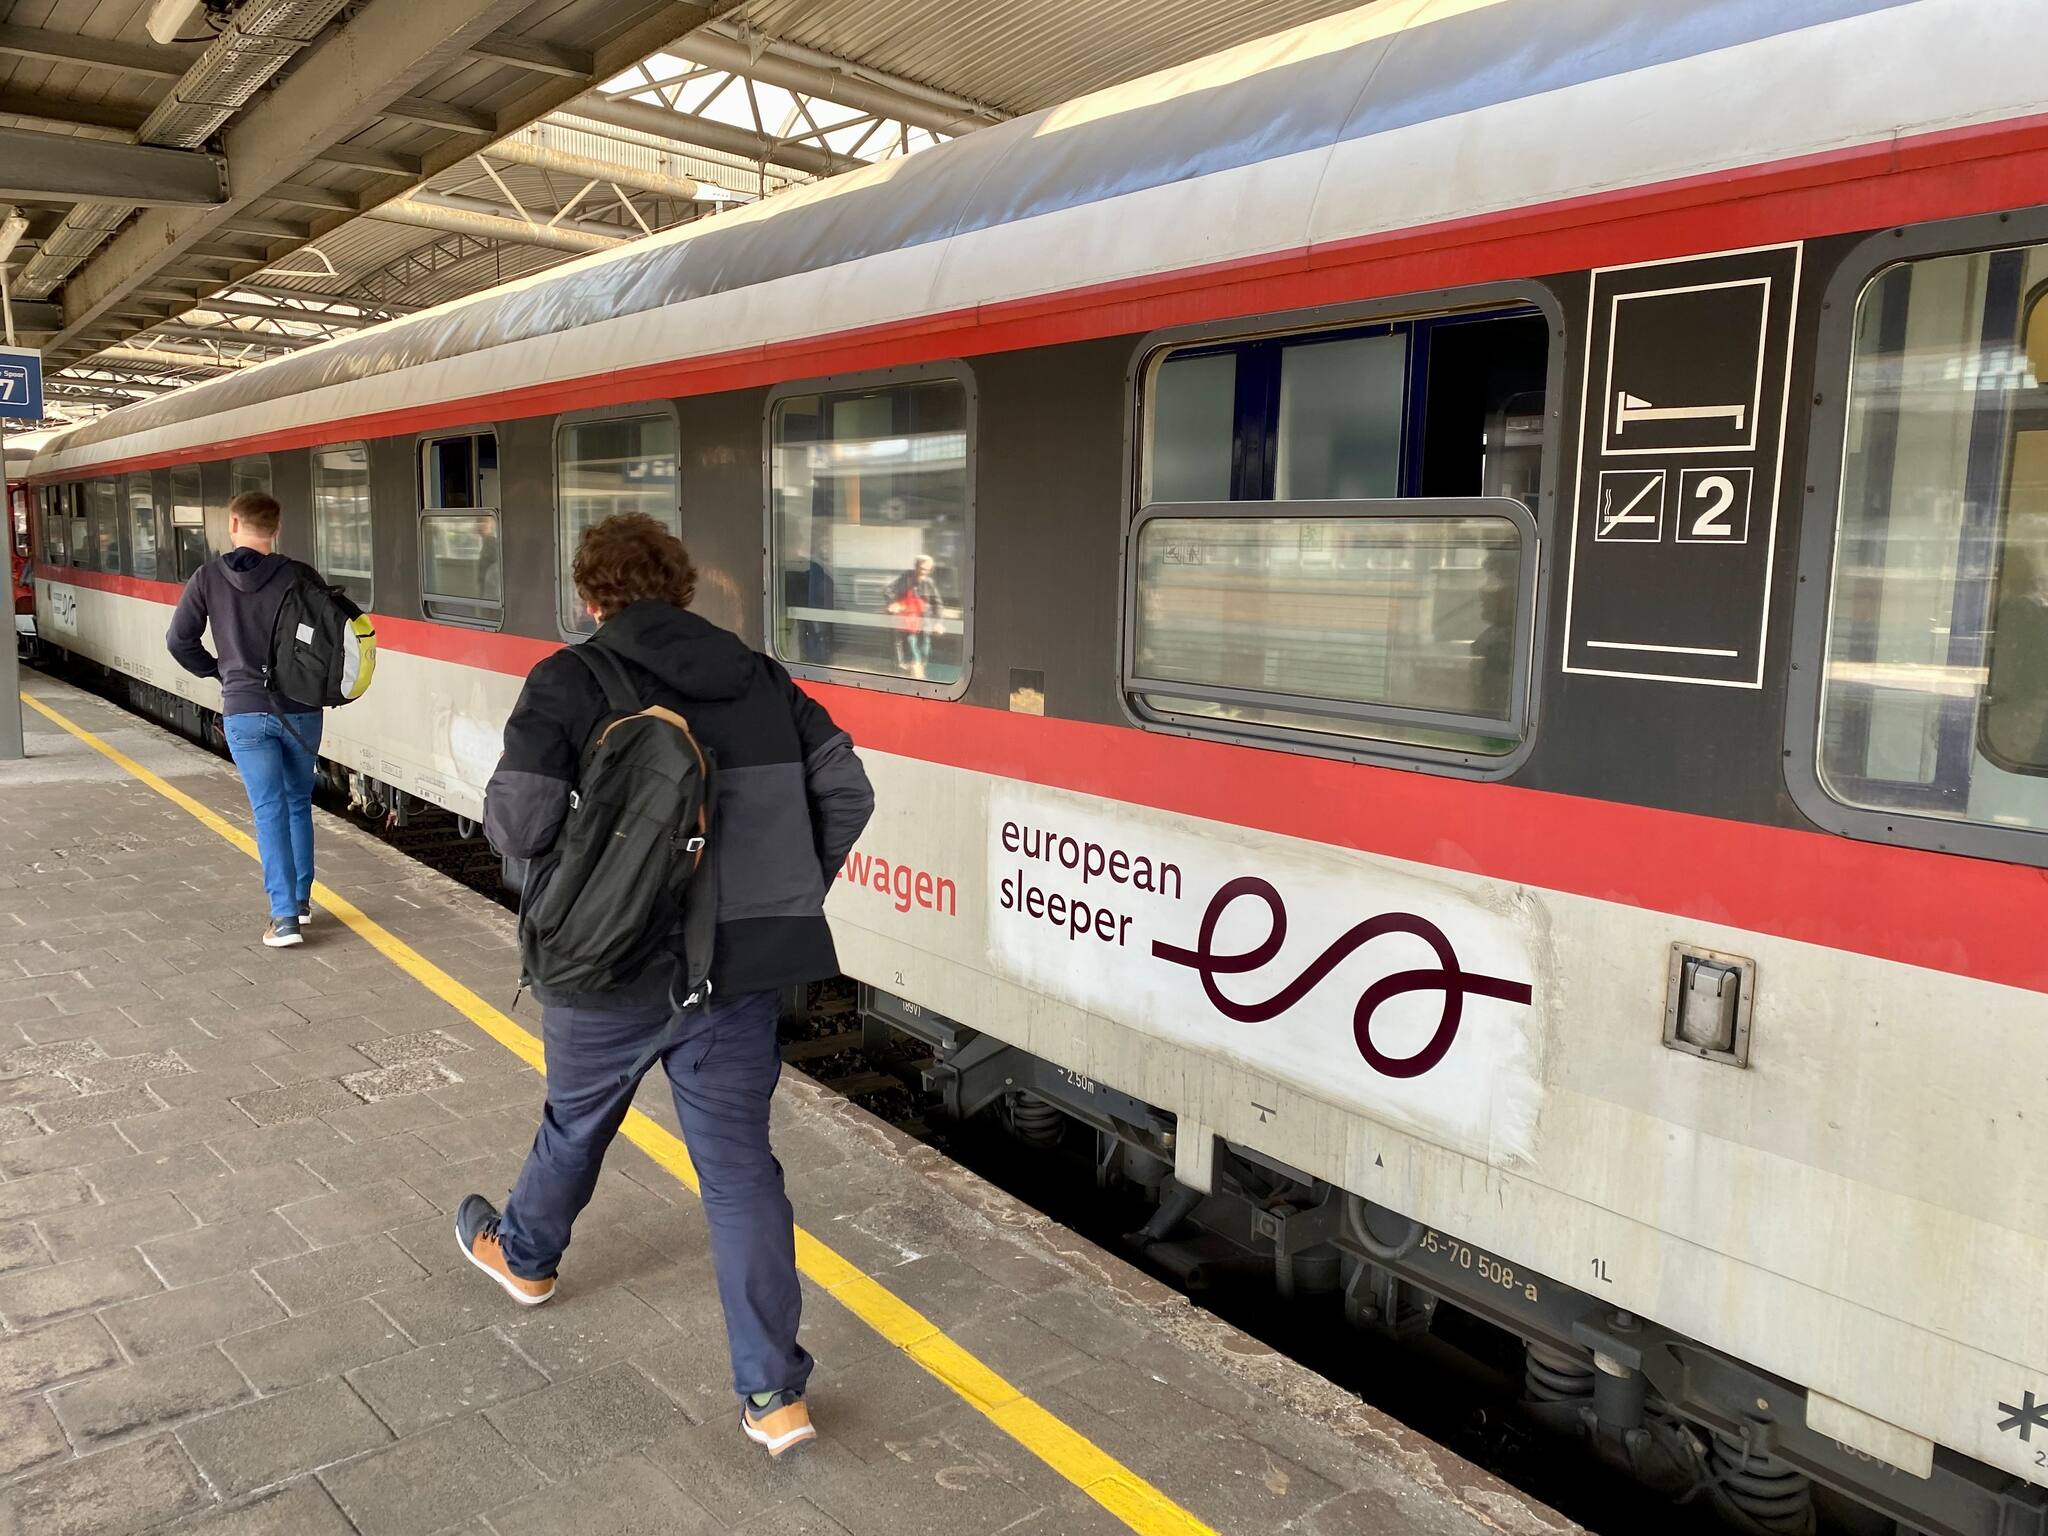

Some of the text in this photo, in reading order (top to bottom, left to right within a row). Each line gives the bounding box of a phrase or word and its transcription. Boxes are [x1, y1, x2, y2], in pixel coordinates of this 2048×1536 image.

[1692, 476, 1734, 535] 2
[838, 851, 956, 916] wagen
[1002, 821, 1182, 900] european
[1000, 869, 1133, 946] sleeper
[1478, 1254, 1538, 1302] 508-a
[1591, 1258, 1613, 1284] 1L
